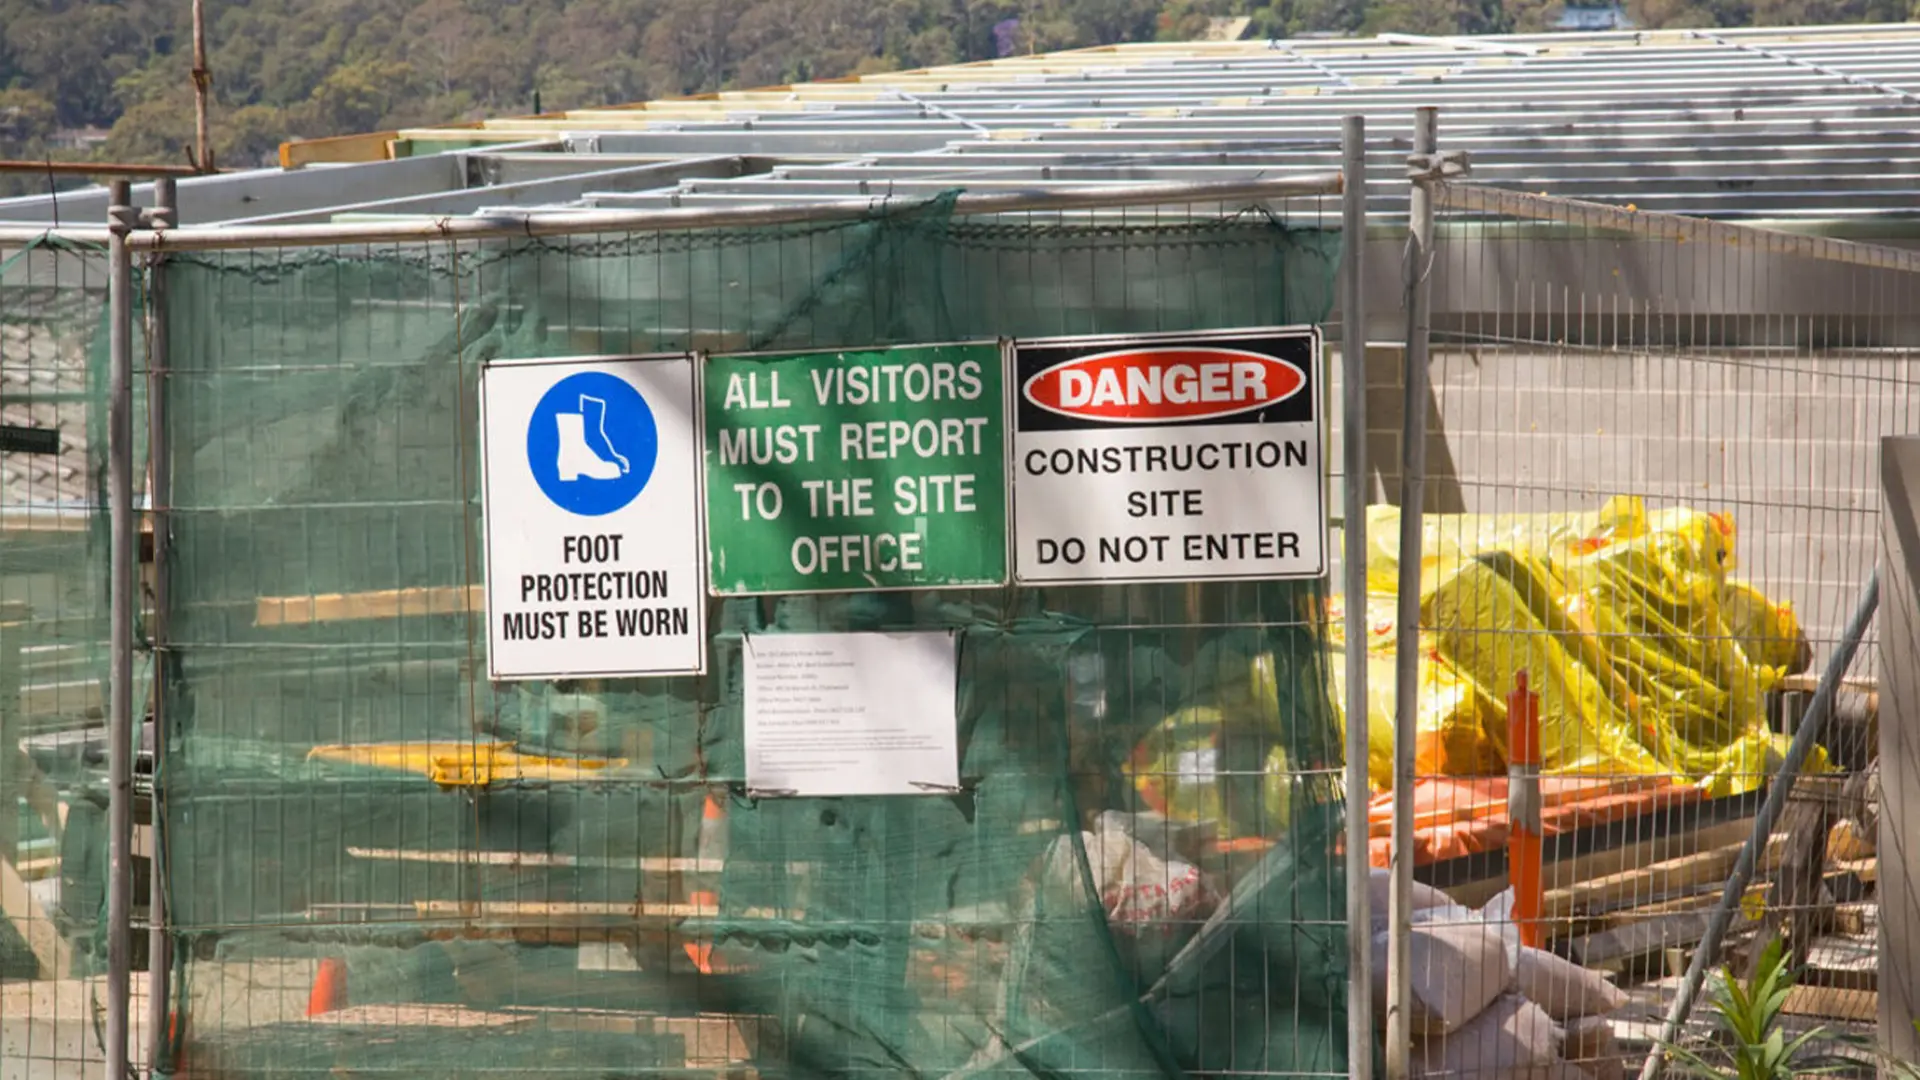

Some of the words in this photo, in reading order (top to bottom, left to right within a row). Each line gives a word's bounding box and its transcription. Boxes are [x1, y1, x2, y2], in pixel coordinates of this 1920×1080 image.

[724, 370, 791, 410] ALL
[811, 360, 983, 406] VISITORS
[1059, 362, 1268, 409] DANGER
[719, 424, 821, 466] MUST
[840, 417, 989, 461] REPORT
[1024, 440, 1308, 476] CONSTRUCTION
[734, 482, 783, 521] TO
[801, 478, 874, 518] THE
[893, 474, 977, 516] SITE
[1127, 489, 1203, 518] SITE
[563, 534, 623, 564] FOOT
[791, 533, 923, 575] OFFICE
[1037, 537, 1085, 565] DO
[1099, 536, 1170, 563] NOT
[1183, 532, 1300, 561] ENTER
[520, 570, 668, 602] PROTECTION
[503, 611, 569, 641] MUST
[577, 609, 608, 638] BE
[616, 607, 689, 637] WORN
